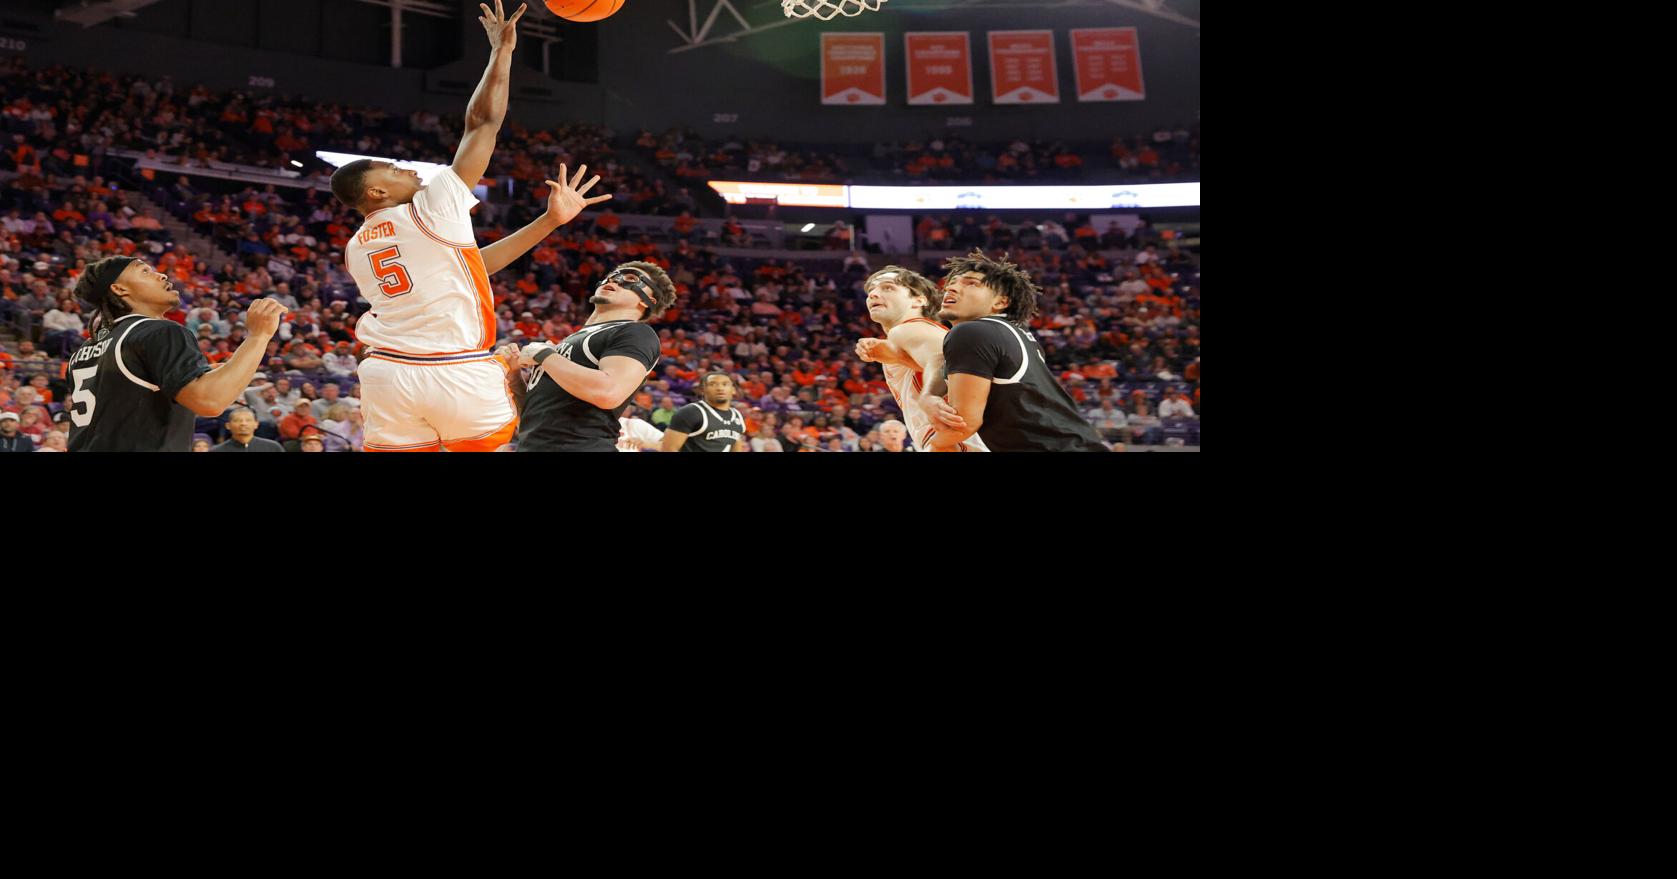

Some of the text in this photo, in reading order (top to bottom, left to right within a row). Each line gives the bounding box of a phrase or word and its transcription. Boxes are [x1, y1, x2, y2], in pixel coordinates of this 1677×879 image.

[248, 75, 275, 88] 209
[358, 221, 396, 245] FOSTER
[367, 245, 413, 298] 5
[71, 364, 99, 427] 5
